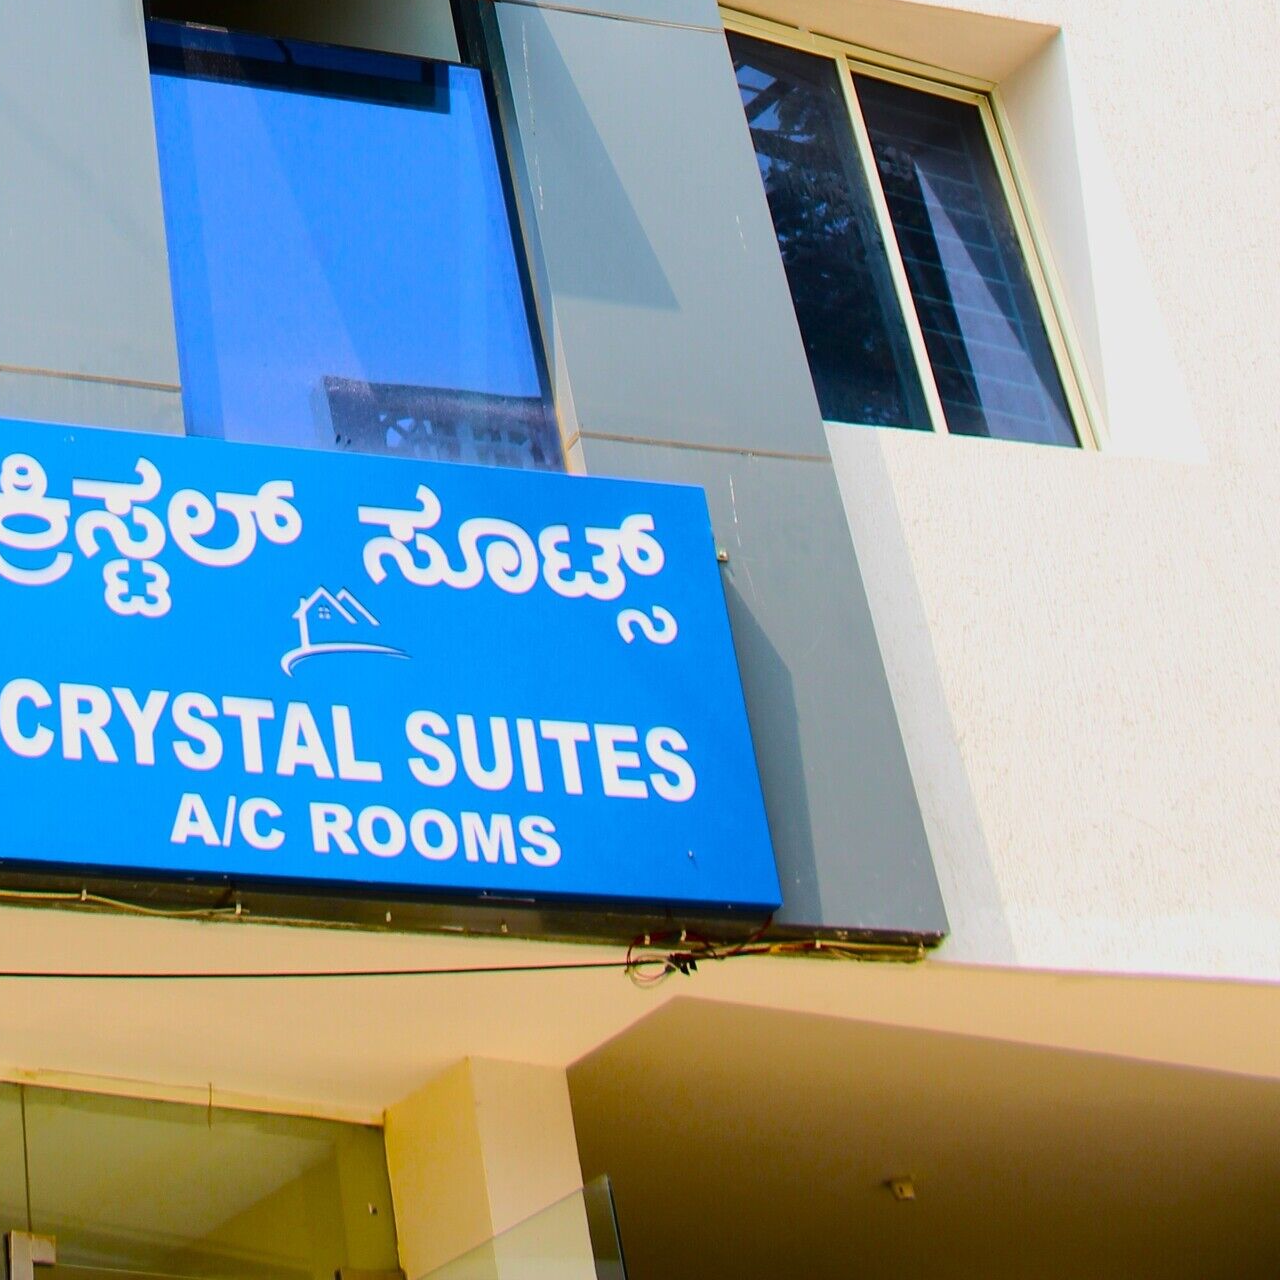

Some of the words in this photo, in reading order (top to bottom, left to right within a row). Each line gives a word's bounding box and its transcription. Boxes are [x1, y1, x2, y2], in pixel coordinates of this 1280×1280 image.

[358, 484, 678, 645] ಸೂಟ್ಸ್
[405, 710, 697, 803] SUITES
[170, 793, 285, 851] A/C
[309, 802, 562, 867] ROOMS
